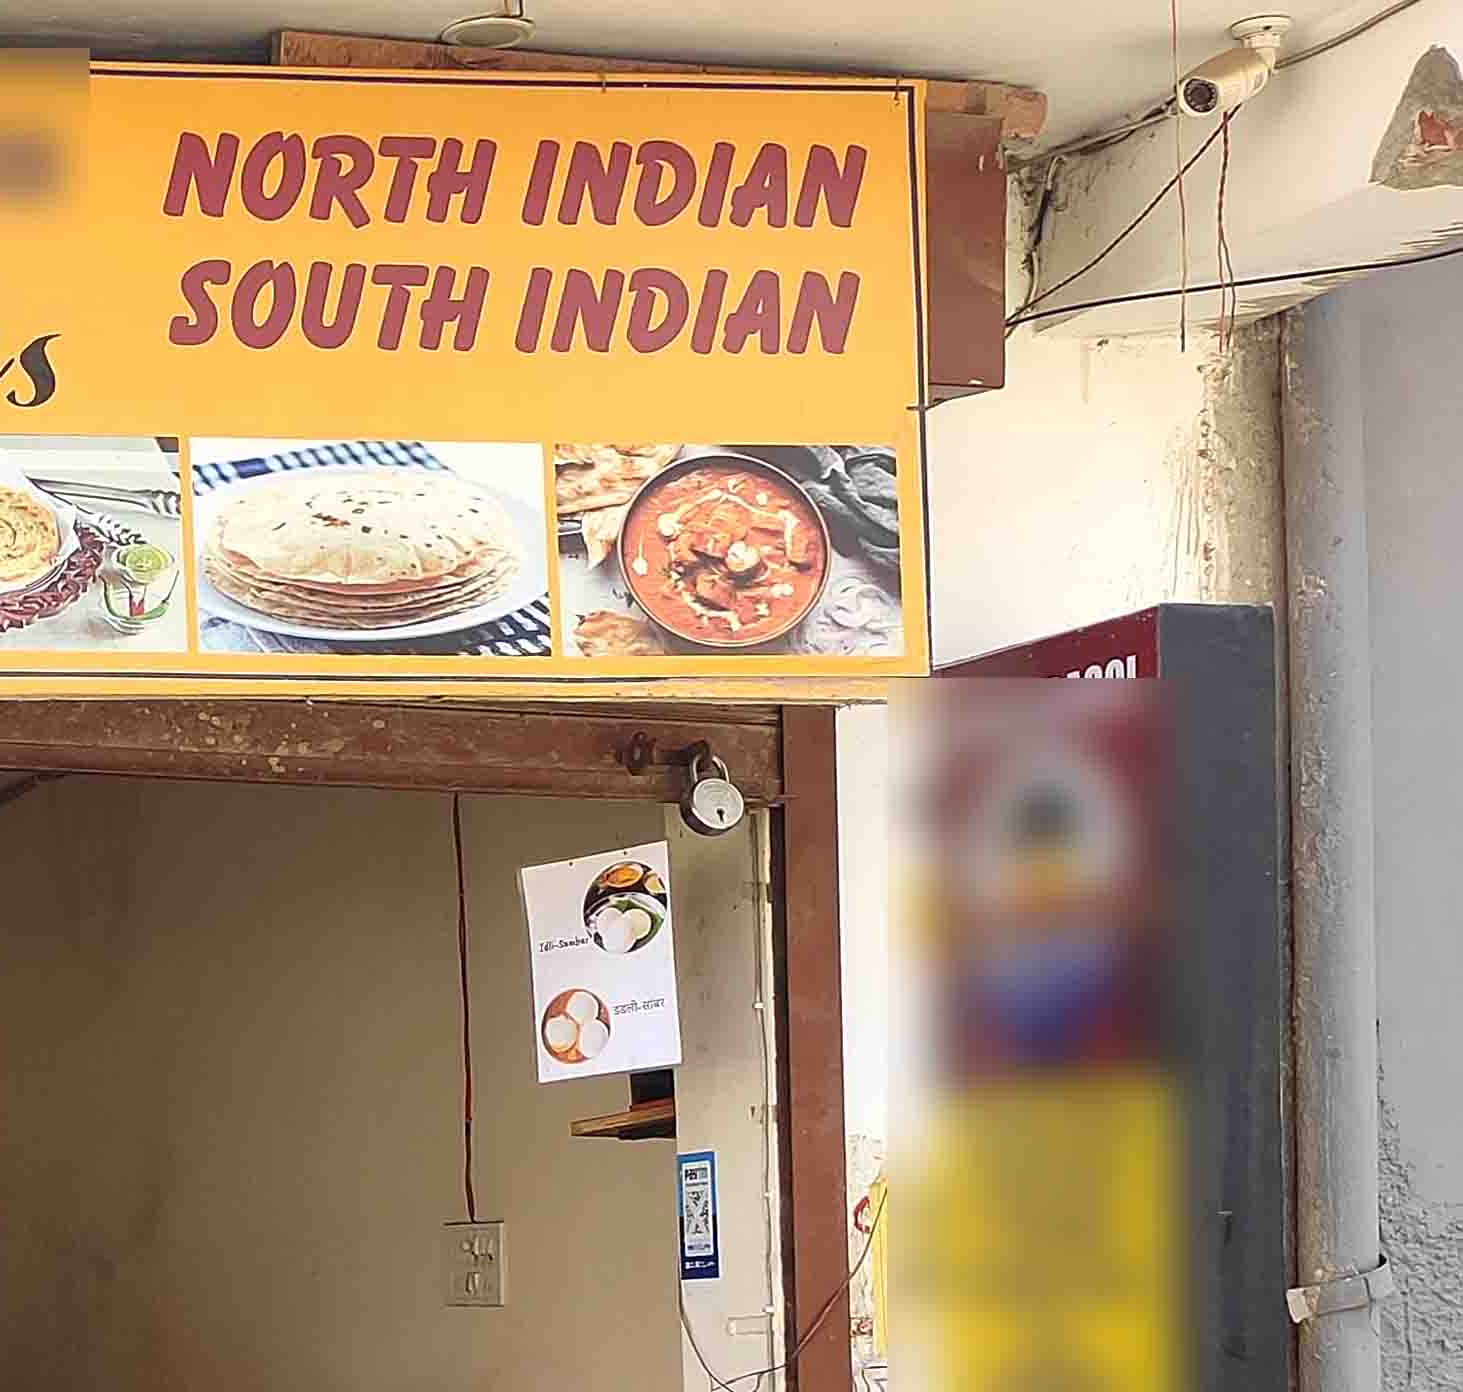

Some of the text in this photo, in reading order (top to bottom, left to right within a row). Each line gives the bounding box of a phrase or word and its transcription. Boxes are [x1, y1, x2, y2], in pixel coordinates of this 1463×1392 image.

[161, 131, 495, 229] NORTH
[523, 138, 869, 230] INDIAN
[167, 259, 862, 355] SOUTH INDIAN
